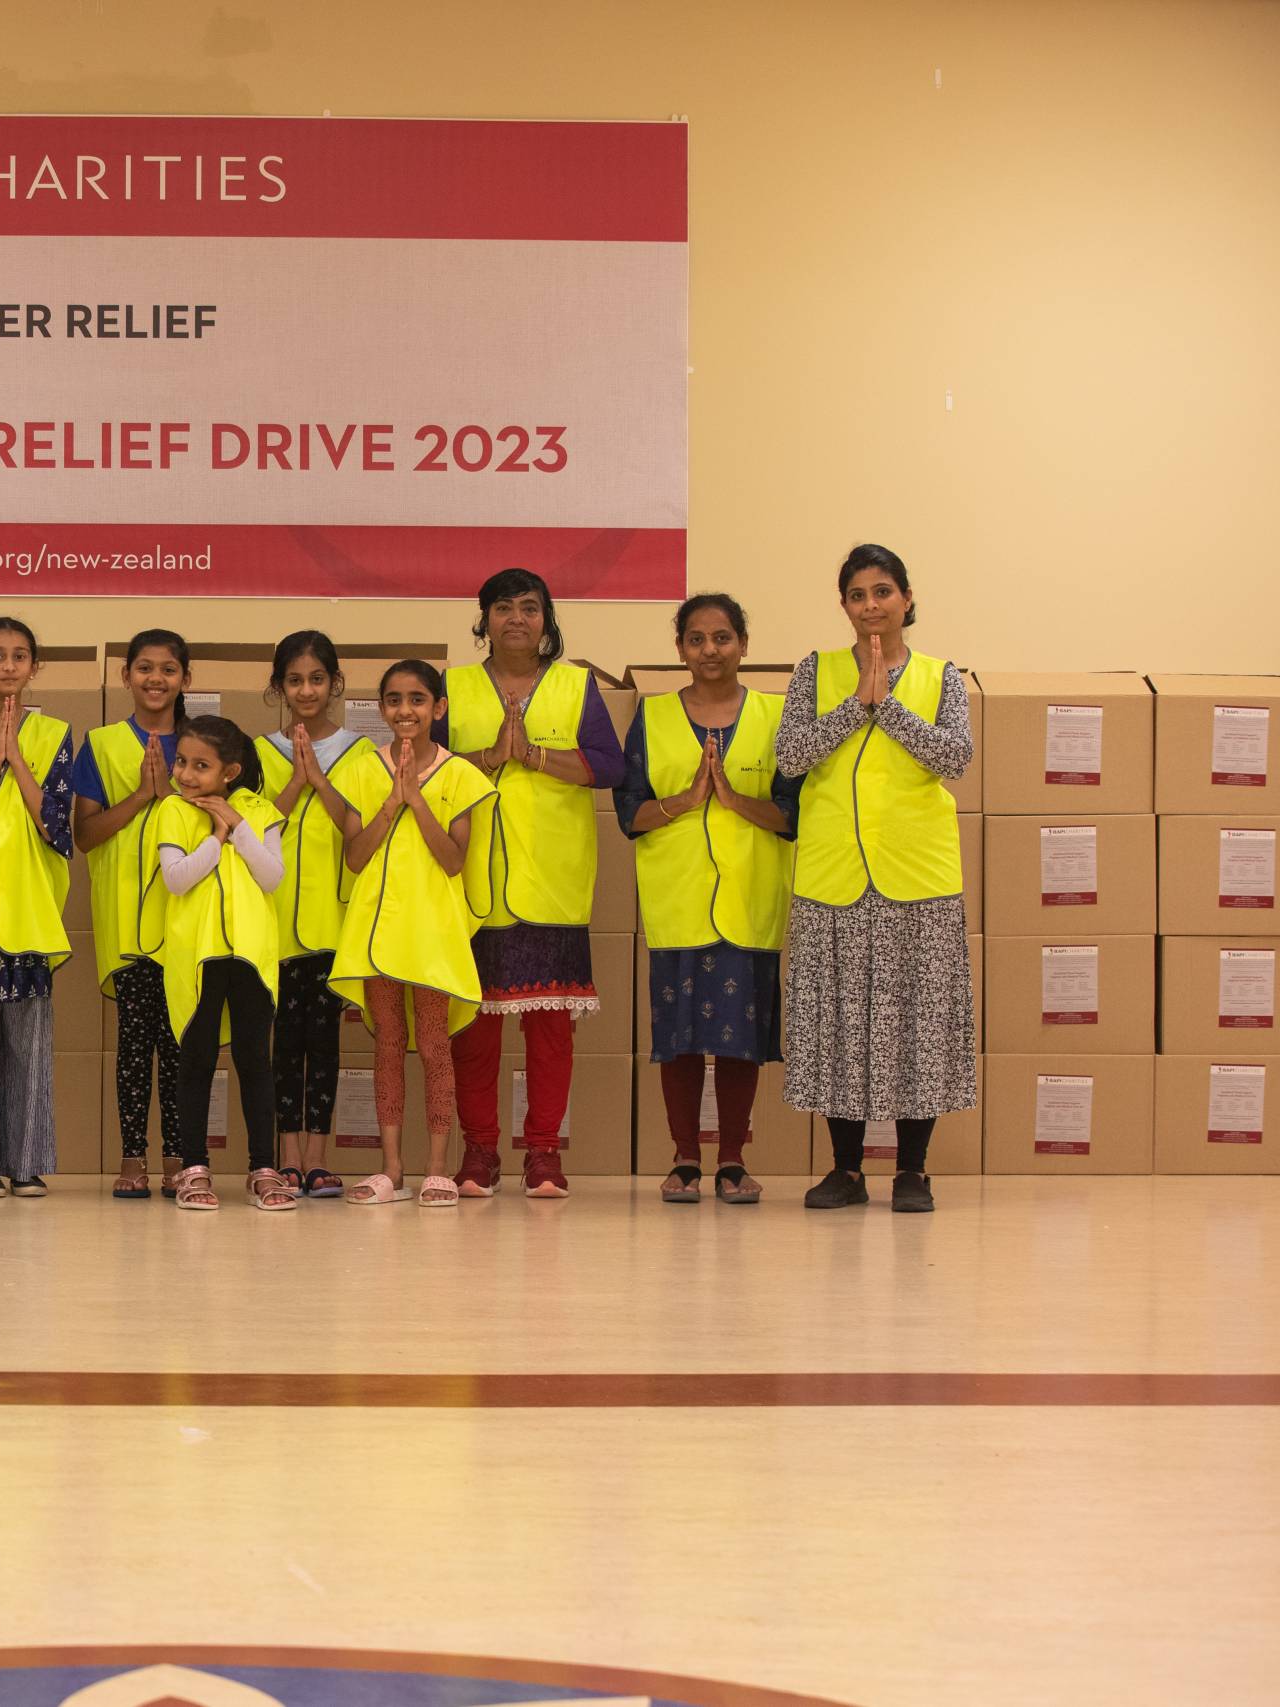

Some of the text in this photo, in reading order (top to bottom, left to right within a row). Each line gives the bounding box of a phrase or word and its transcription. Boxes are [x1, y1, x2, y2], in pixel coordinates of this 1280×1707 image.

[66, 304, 217, 340] RELIEF
[211, 423, 396, 472] DRIVE
[413, 424, 569, 474] 2023
